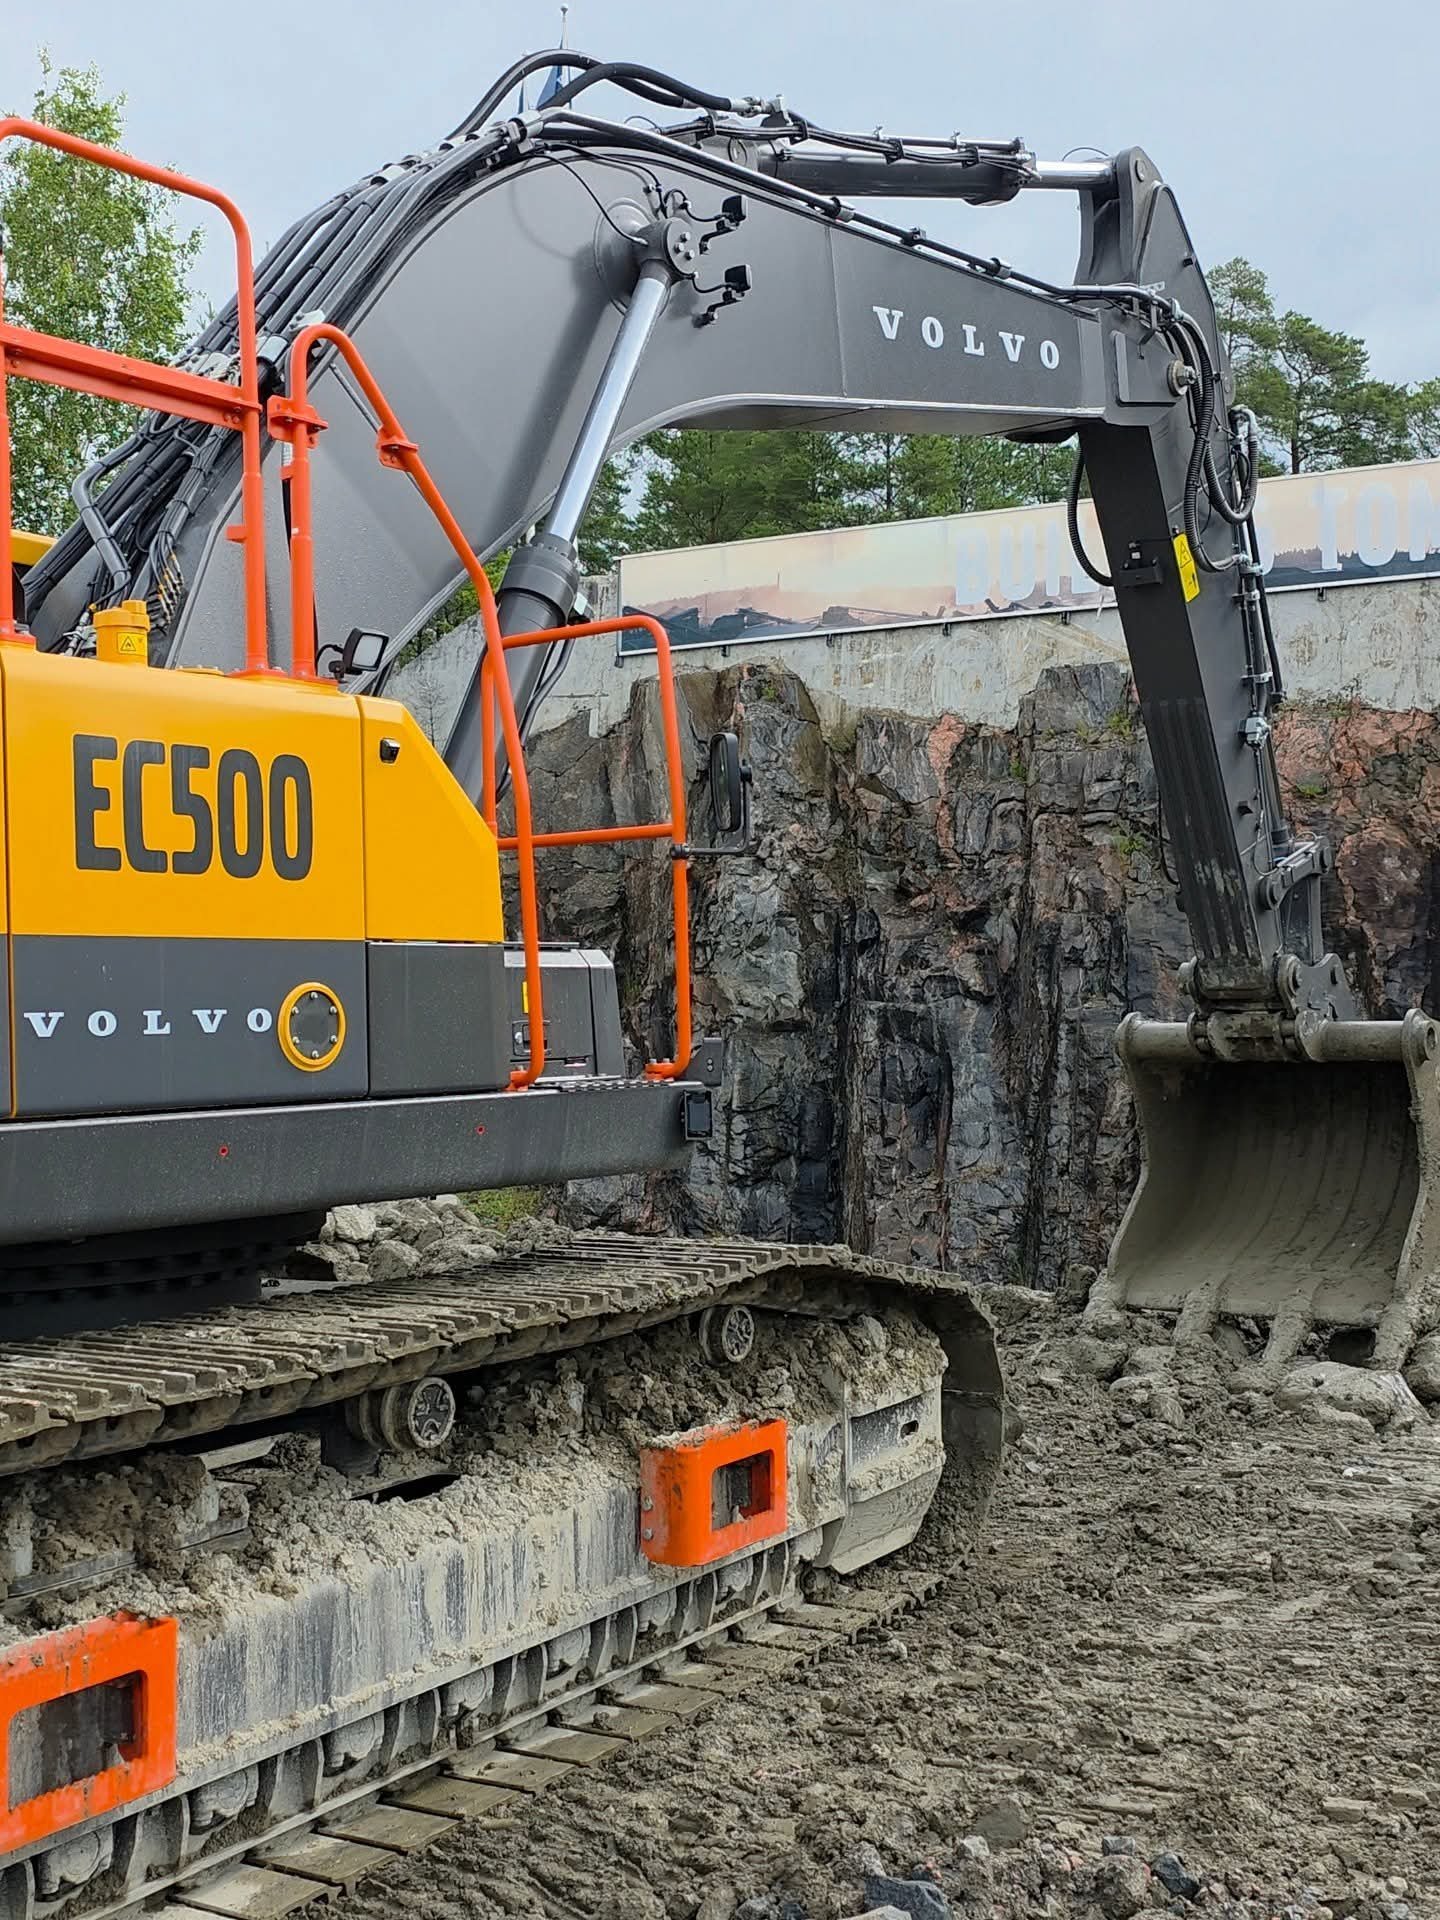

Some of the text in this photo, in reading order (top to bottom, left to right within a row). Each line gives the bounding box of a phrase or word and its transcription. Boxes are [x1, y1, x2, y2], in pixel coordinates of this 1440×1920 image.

[873, 306, 1060, 370] VOLVO
[73, 733, 313, 881] EC500
[23, 1008, 273, 1038] VOLVO
